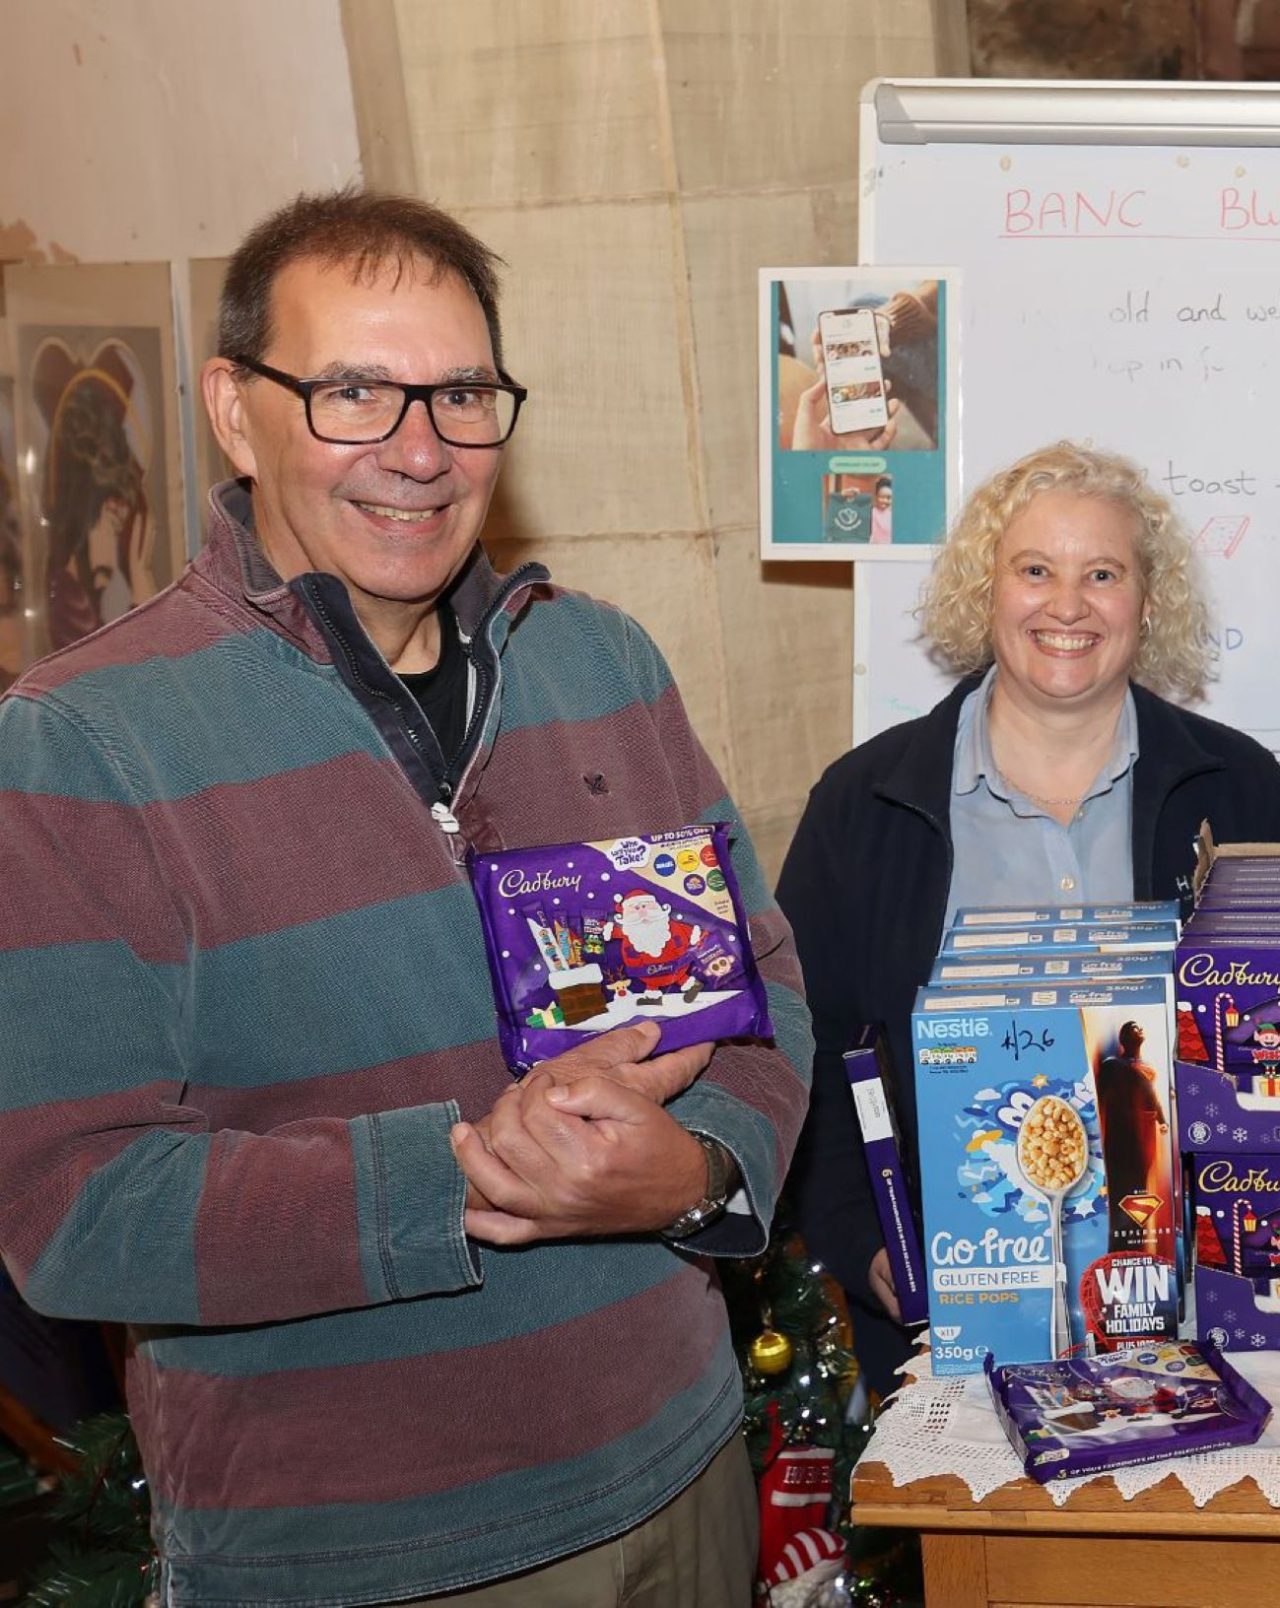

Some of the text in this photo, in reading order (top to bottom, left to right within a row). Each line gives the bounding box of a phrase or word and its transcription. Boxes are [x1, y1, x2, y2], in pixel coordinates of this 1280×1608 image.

[1003, 189, 1147, 235] BANC
[1109, 291, 1149, 324] old
[1177, 293, 1226, 322] and
[1162, 460, 1257, 496] toast
[498, 869, 582, 897] Cadbury
[1112, 1258, 1141, 1267] CHANCE
[939, 1271, 1040, 1287] GLUTEN FREE
[1095, 1264, 1170, 1305] WIN
[979, 1292, 1020, 1304] POPS
[1113, 1303, 1157, 1319] FAMILY
[1105, 1317, 1165, 1334] HOLIDAYS
[934, 1346, 974, 1361] 350g
